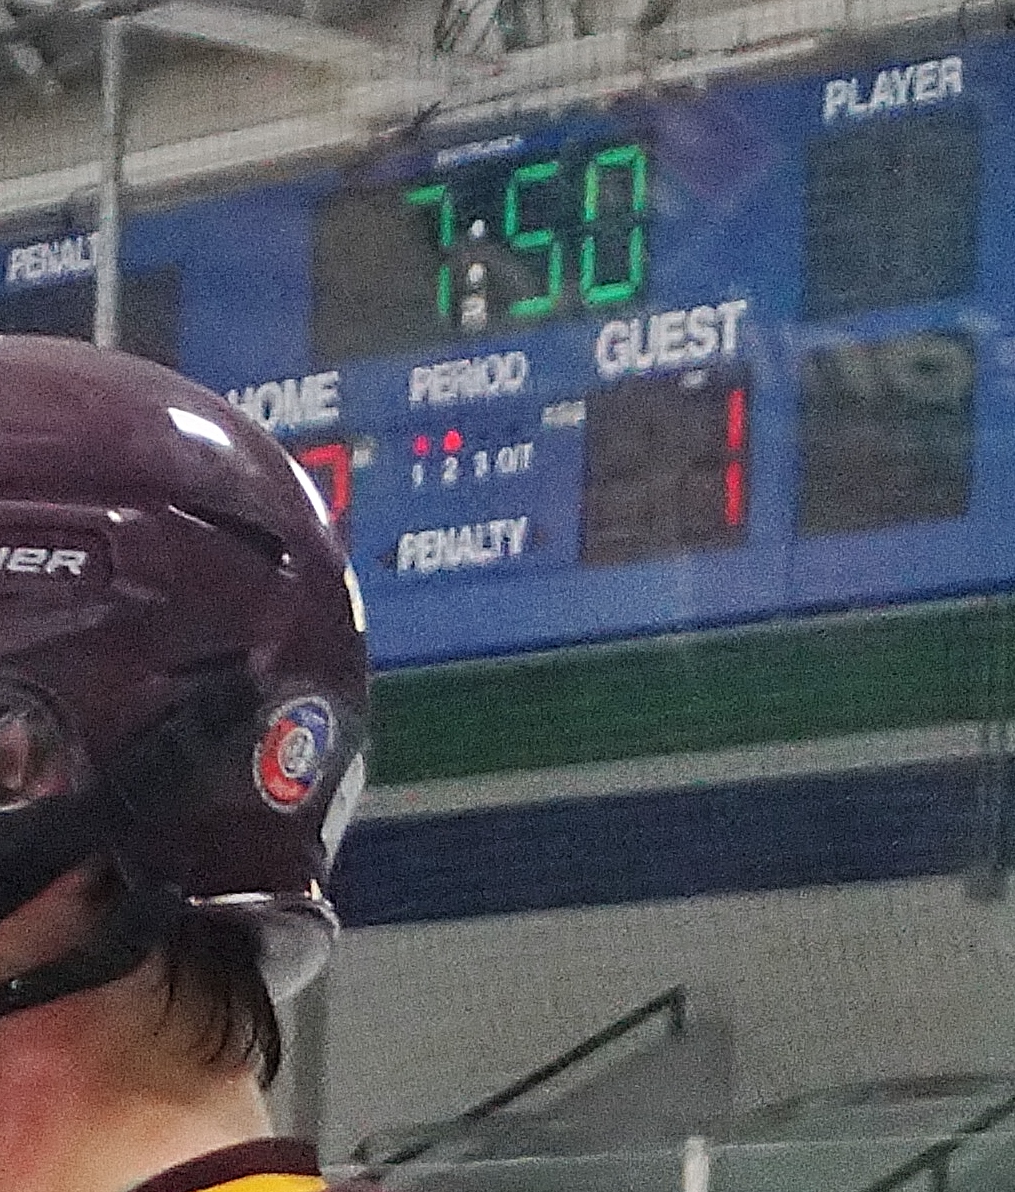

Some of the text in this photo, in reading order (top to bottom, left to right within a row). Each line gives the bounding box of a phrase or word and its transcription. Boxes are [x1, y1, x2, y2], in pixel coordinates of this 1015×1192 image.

[822, 55, 964, 124] PLAYER
[7, 231, 104, 281] PENALT
[596, 299, 747, 376] GUEST
[408, 351, 527, 404] PERIOD
[397, 516, 528, 574] PENALTY
